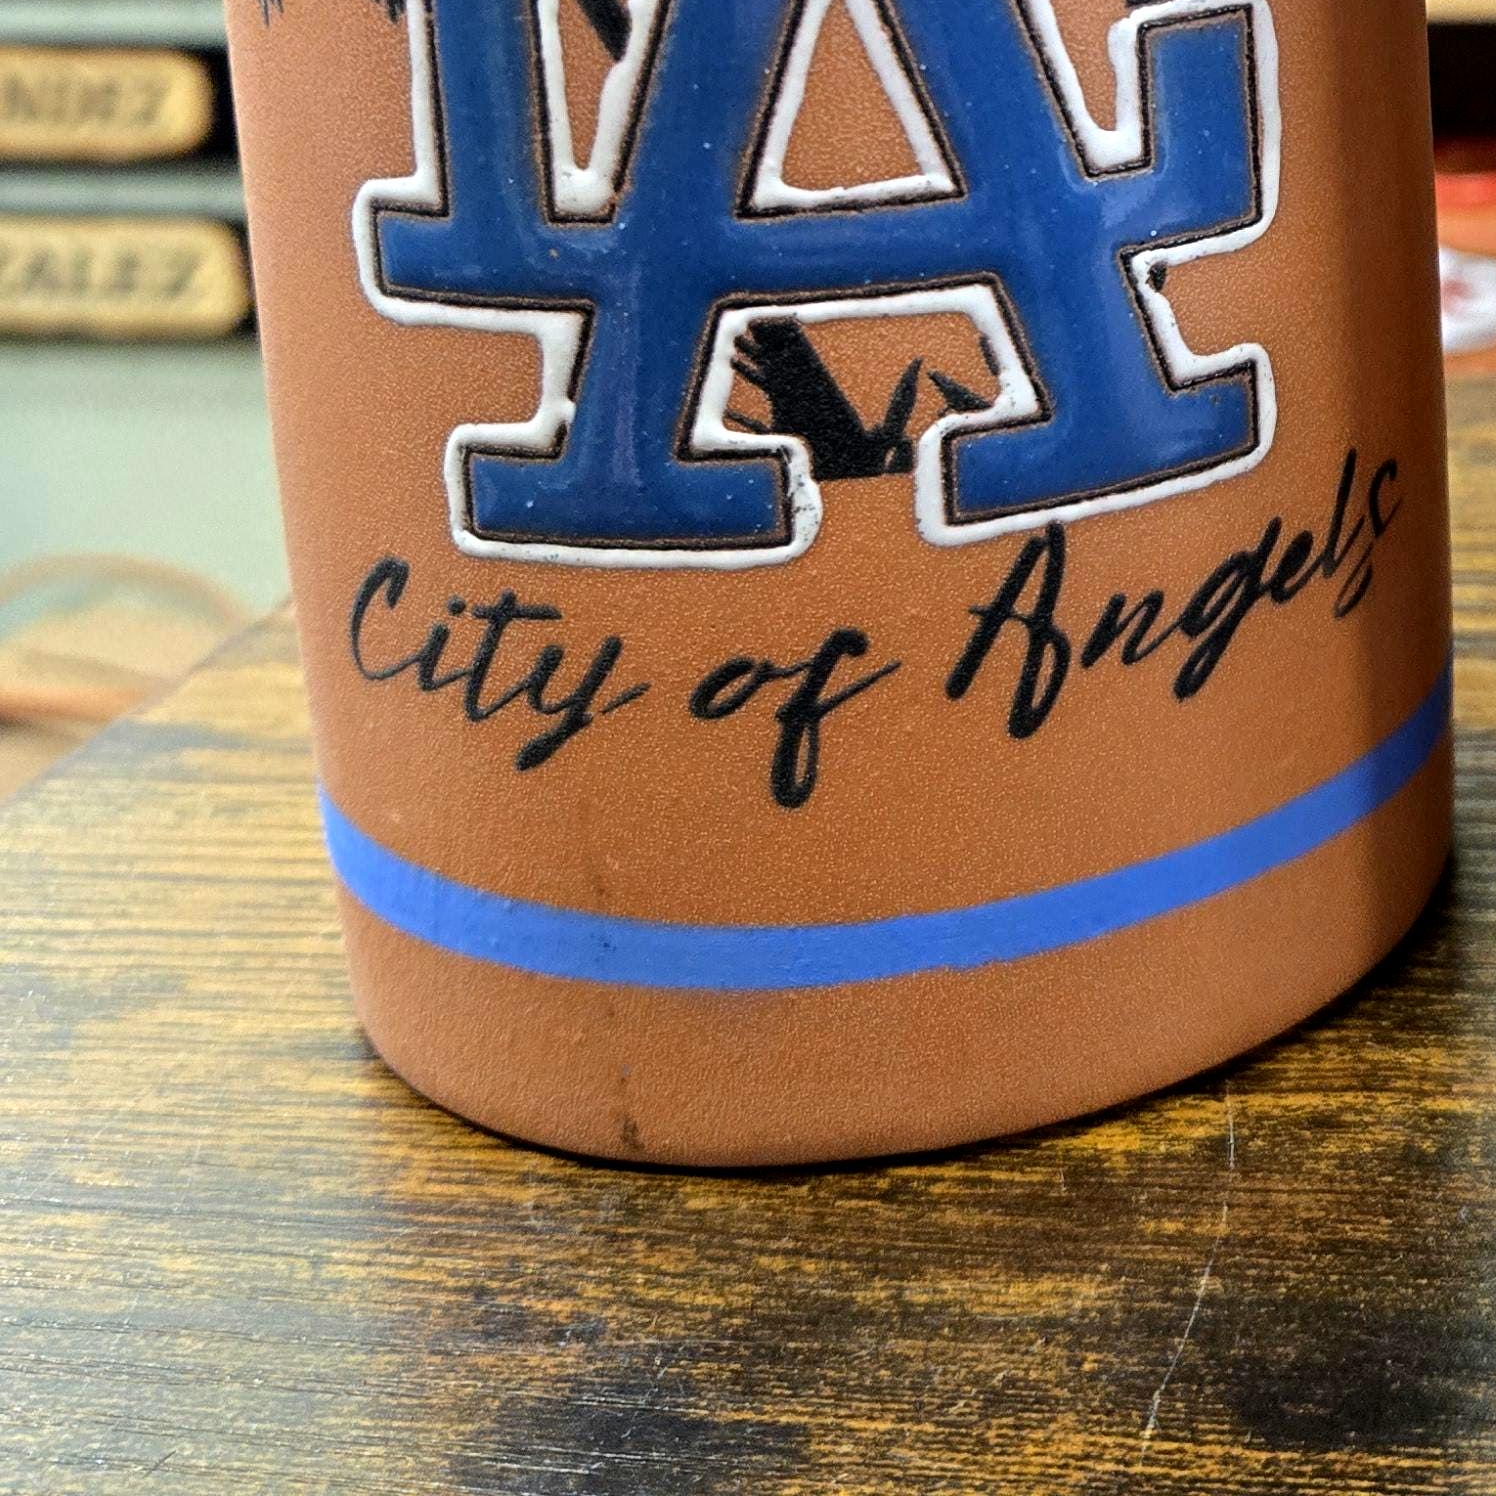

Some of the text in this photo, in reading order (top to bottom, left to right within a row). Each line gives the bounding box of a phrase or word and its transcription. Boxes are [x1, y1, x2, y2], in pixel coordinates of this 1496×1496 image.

[350, 448, 1399, 808] City of Angels
